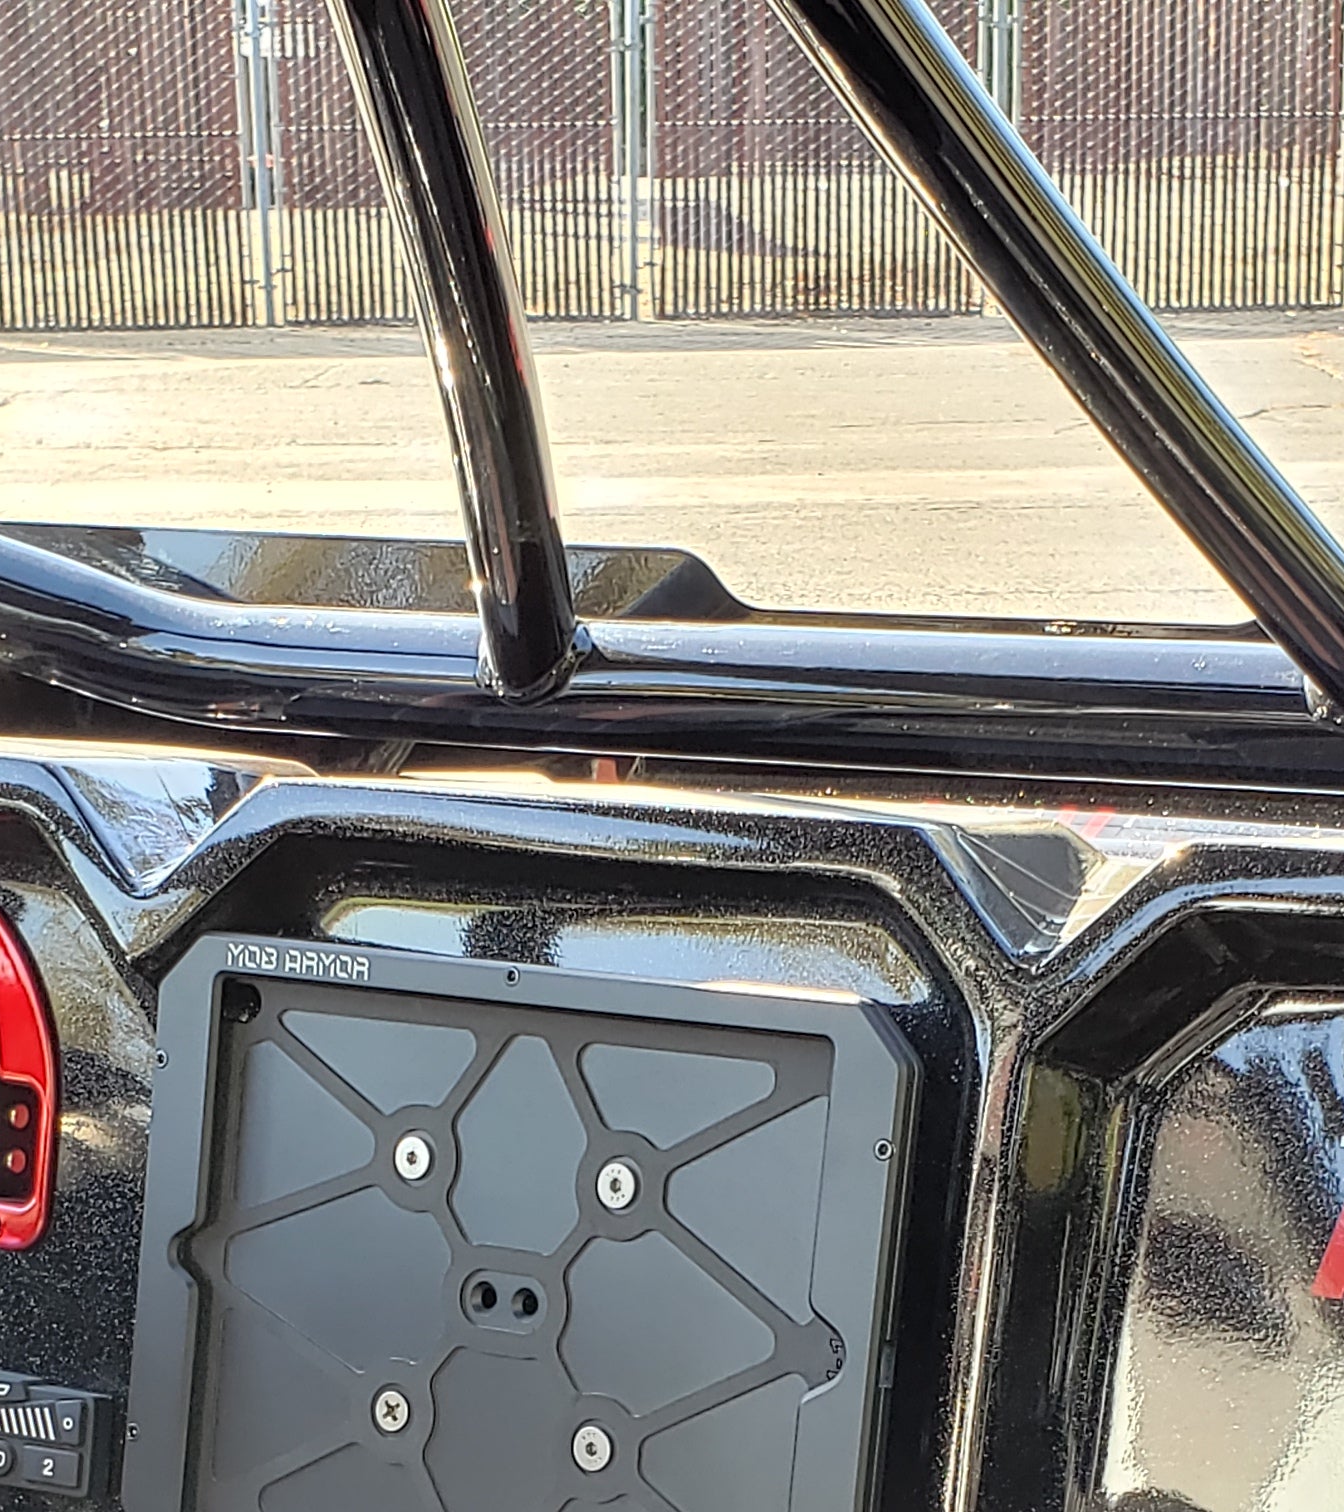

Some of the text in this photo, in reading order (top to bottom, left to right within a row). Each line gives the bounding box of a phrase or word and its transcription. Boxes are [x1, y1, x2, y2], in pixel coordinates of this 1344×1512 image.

[226, 943, 370, 981] MOB ARMOR
[42, 1459, 54, 1476] 2
